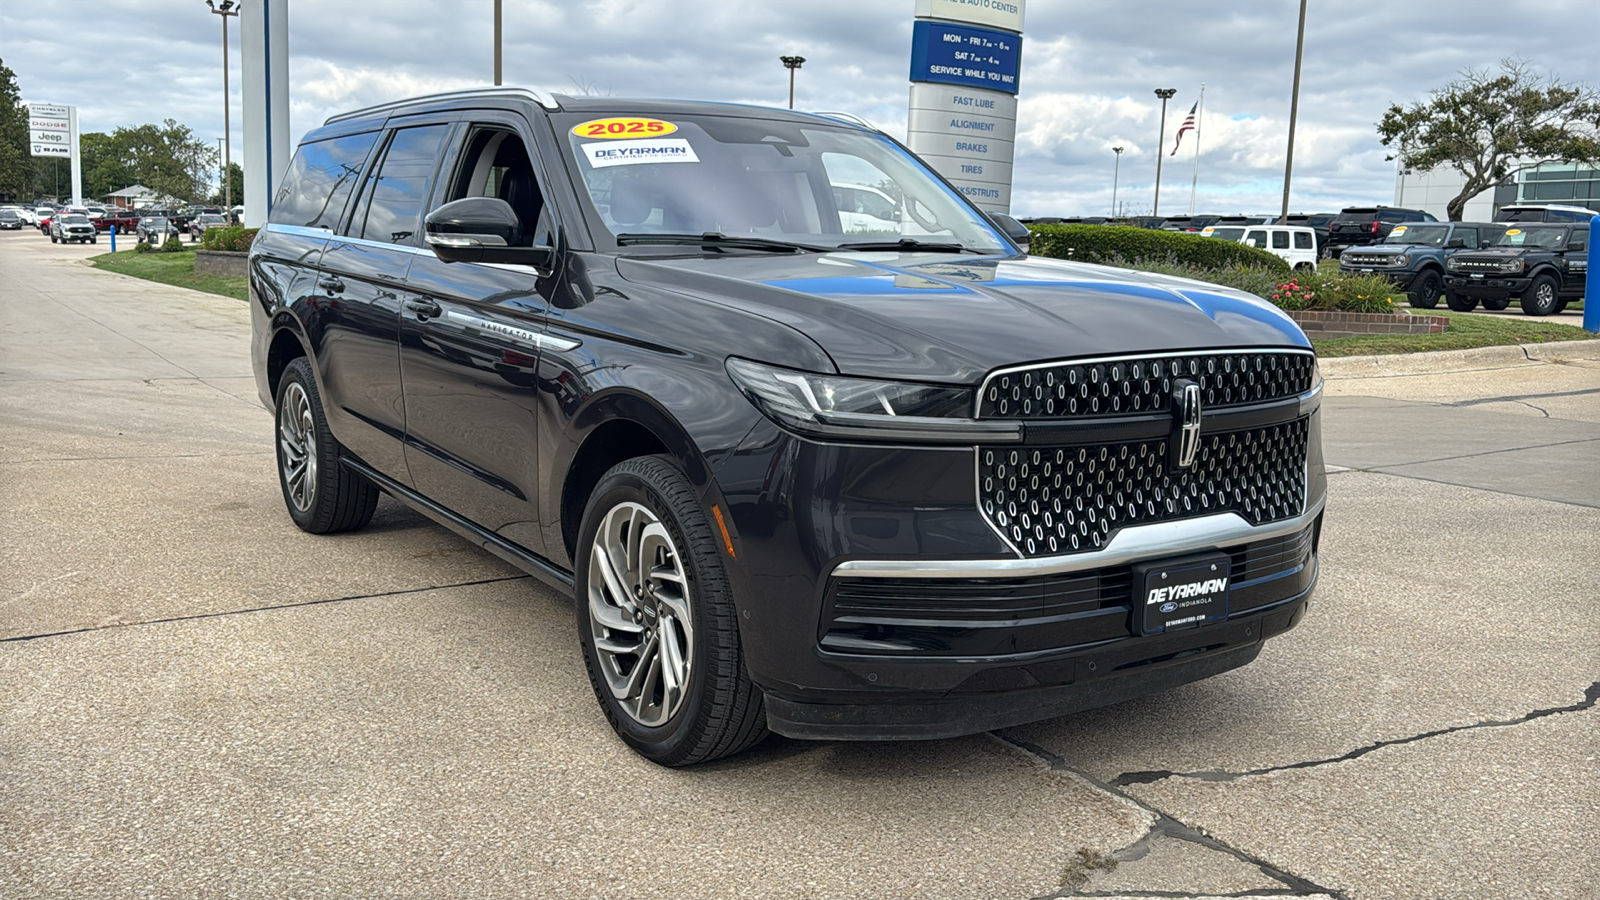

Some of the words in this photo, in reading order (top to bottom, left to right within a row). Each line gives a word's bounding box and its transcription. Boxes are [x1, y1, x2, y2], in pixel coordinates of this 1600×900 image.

[991, 1, 1018, 14] CENTER
[943, 33, 961, 43] MON
[969, 36, 981, 46] FRI
[955, 51, 968, 60] SAT
[930, 65, 962, 75] SERVICE
[964, 68, 986, 79] WHILE
[987, 72, 1000, 81] YOU
[1002, 74, 1014, 83] WAIT
[953, 95, 974, 106] FAST
[974, 98, 995, 109] LUBE
[588, 122, 664, 135] 2025
[950, 119, 995, 131] ALIGNMENT
[38, 132, 62, 142] Jeep
[595, 147, 685, 157] DEYARMAN
[956, 142, 988, 153] BRAKES
[961, 165, 983, 174] TIRES
[481, 322, 532, 340] NAVIGATOR
[1147, 578, 1227, 605] DEYARMAN
[1179, 597, 1212, 608] INDIANOLA
